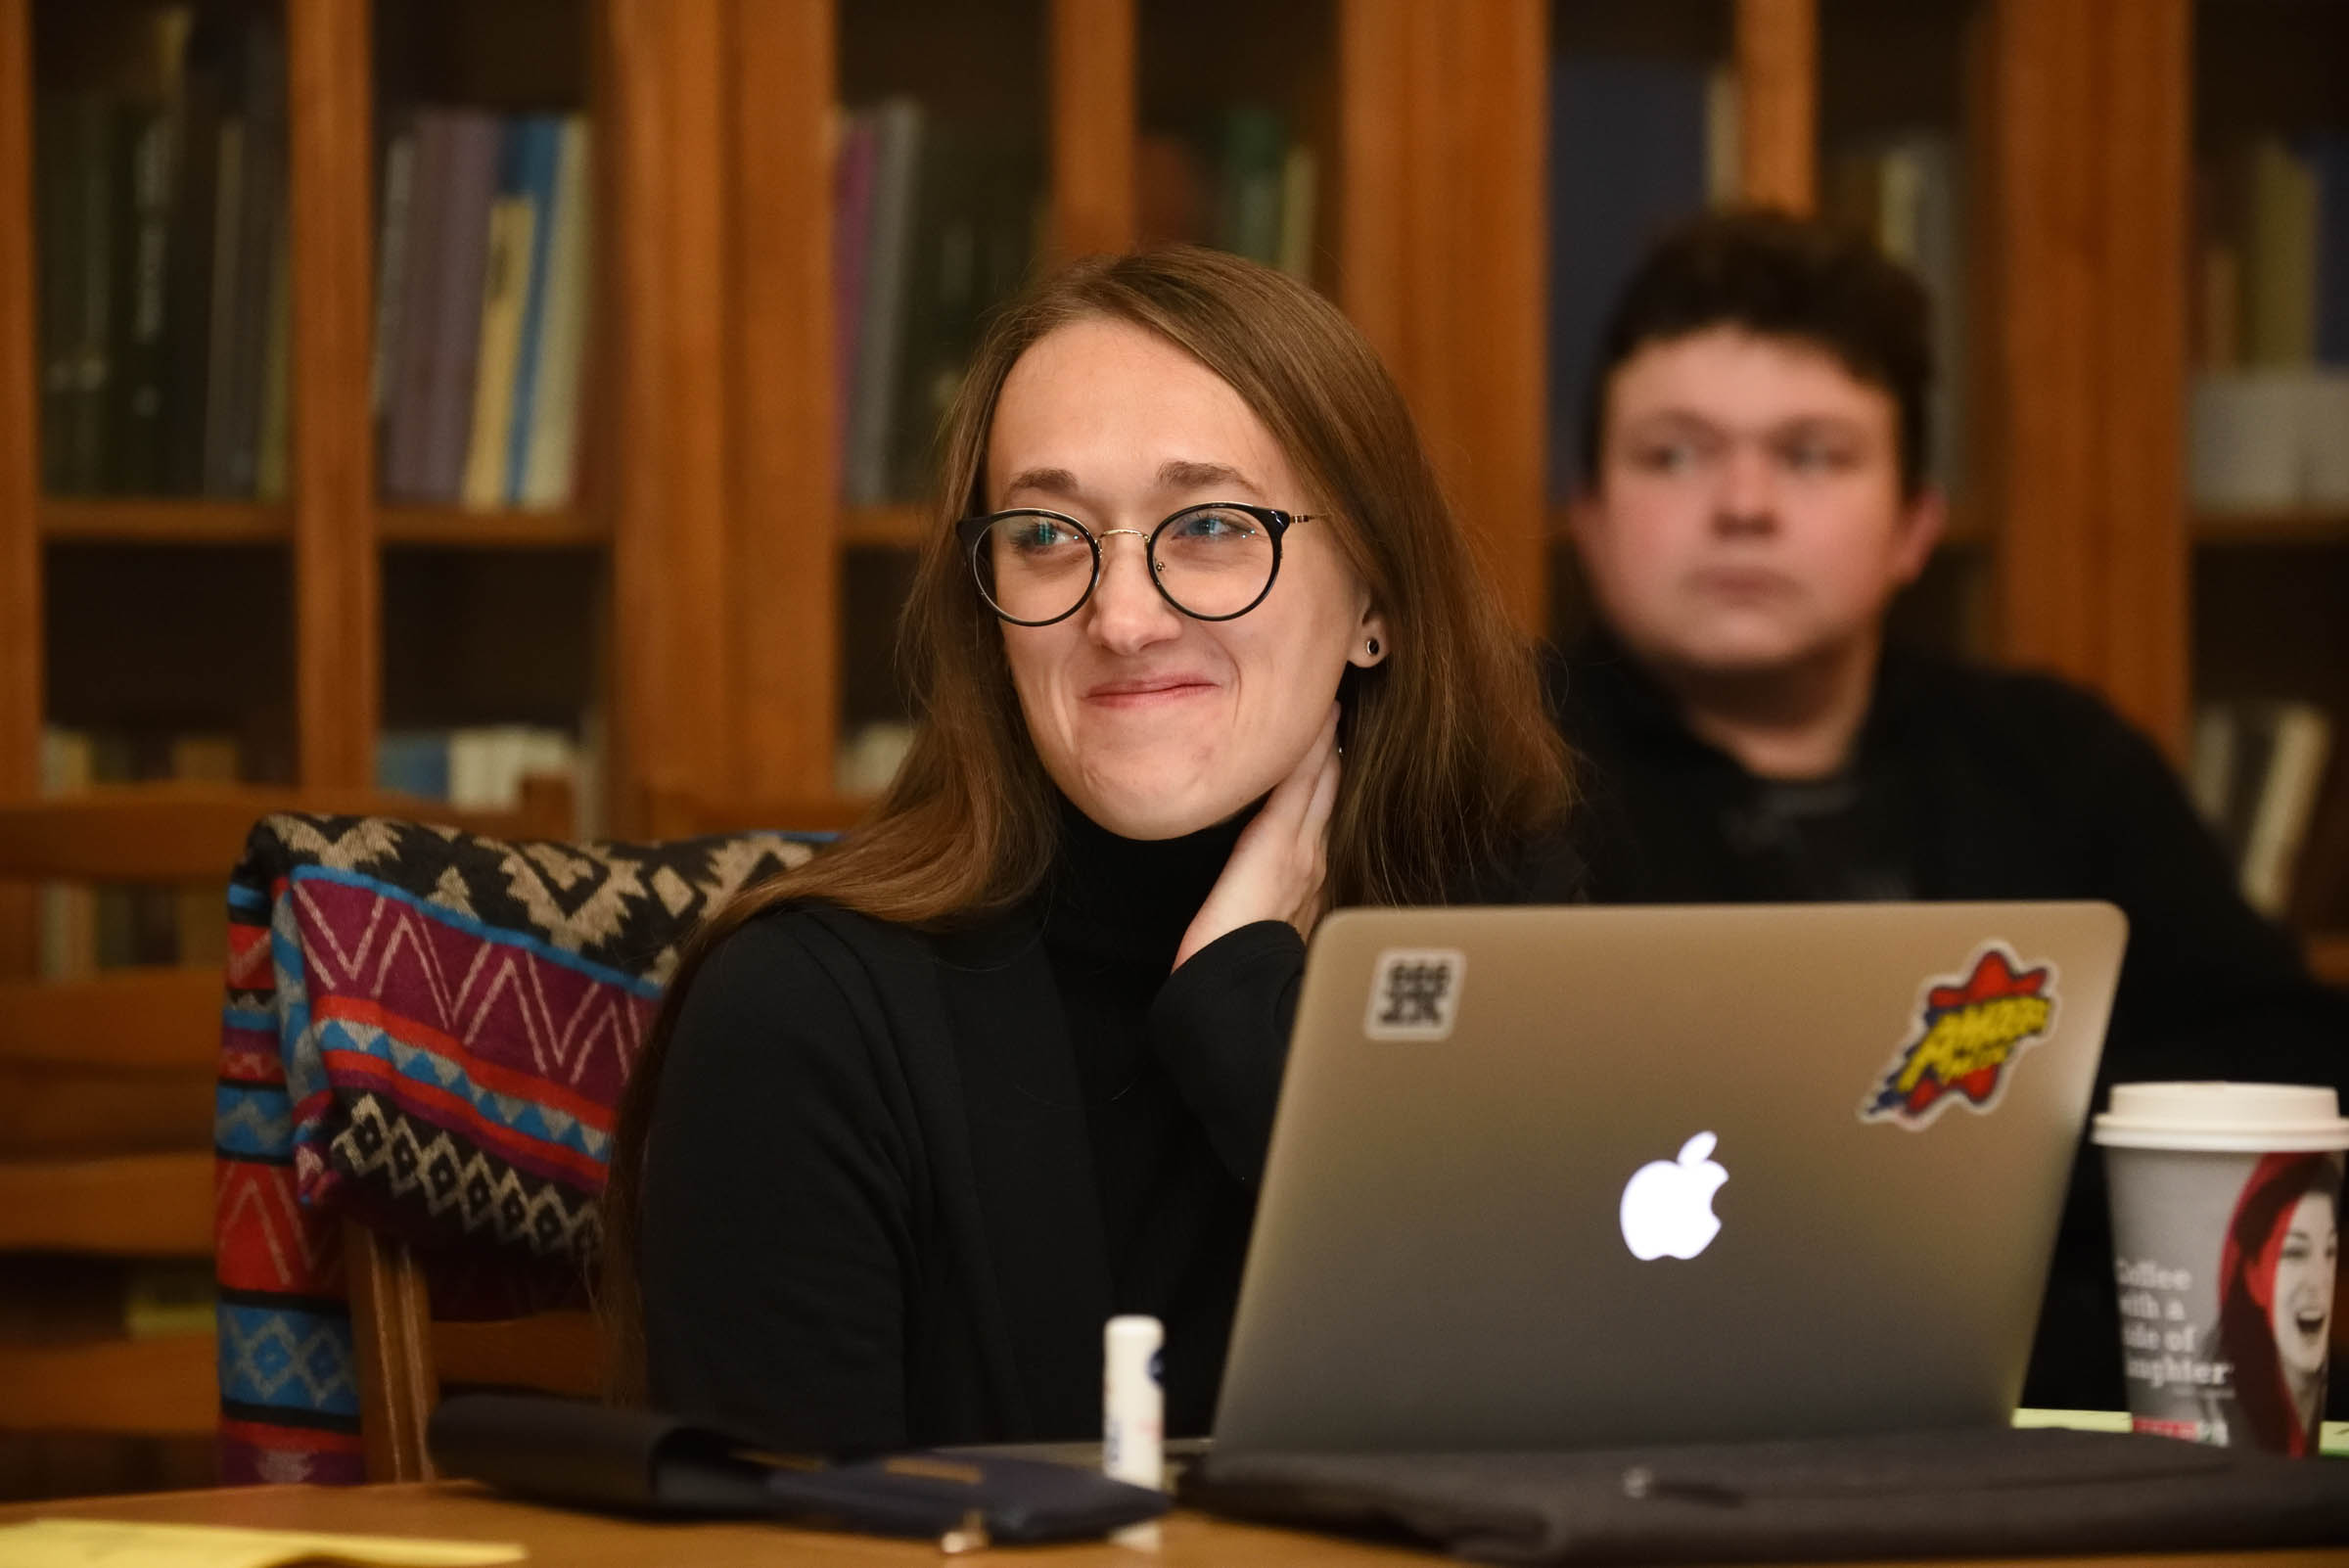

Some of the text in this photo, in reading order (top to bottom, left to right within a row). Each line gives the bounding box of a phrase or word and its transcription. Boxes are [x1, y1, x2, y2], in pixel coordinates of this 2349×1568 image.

[2165, 1299, 2185, 1320] a
[2164, 1324, 2195, 1353] of
[2126, 1355, 2234, 1389] aughter
